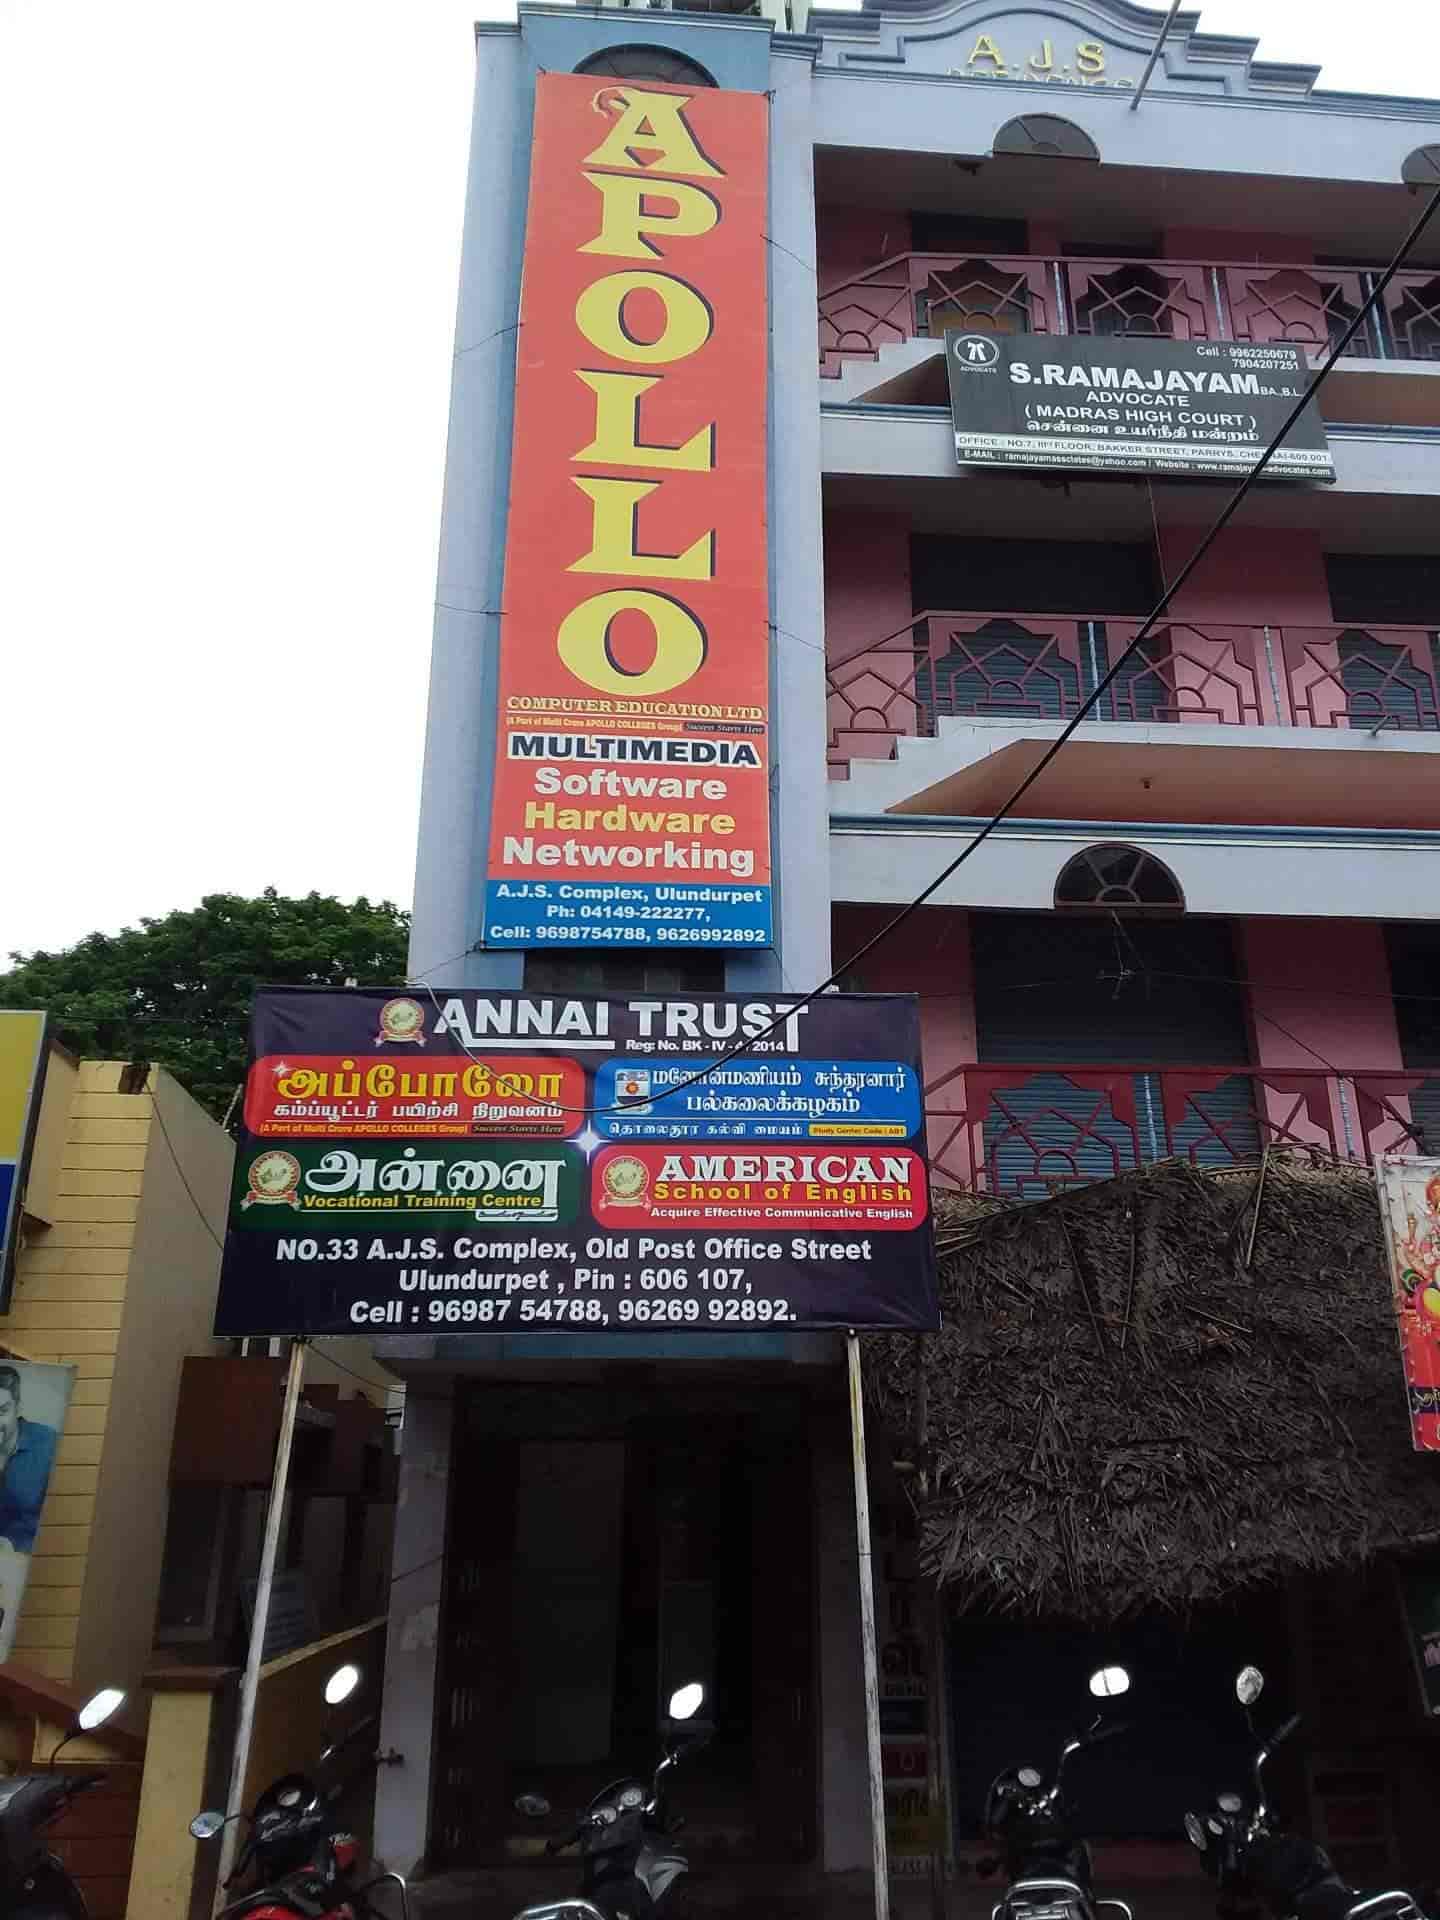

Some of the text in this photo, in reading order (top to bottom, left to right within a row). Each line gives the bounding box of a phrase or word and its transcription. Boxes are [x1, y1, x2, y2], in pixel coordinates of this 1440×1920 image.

[967, 35, 1105, 74] A.J.S
[556, 84, 729, 697] APOLLO
[1009, 362, 1260, 395] S.RAMAJAYAM
[1087, 390, 1191, 407] ADVOCATE
[1036, 405, 1120, 420] MADRAS
[1126, 408, 1172, 423] HIGH
[1178, 412, 1245, 427] COURT
[506, 696, 763, 720] COMPUTER EDUCATION LTD
[509, 733, 761, 767] MULTIMEDIA
[534, 767, 727, 800] Software
[525, 801, 736, 834] Hardware
[503, 837, 754, 877] Networking
[496, 884, 763, 904] A.J.S. Complex, Ulundurpet
[547, 905, 711, 922] Ph: 04149-222277,
[490, 926, 766, 943] Cell: 9698754788, 9626992892
[433, 998, 808, 1051] ANNAI TRUST
[682, 1040, 703, 1051] BK
[277, 1060, 564, 1099] அப்போலோ
[687, 1090, 860, 1118] பல்கலைக்கழகம்
[305, 1148, 566, 1206] அன்னை
[656, 1155, 909, 1183] AMERICAN
[304, 1193, 542, 1210] Vocational Training Centre
[654, 1183, 912, 1203] School of English
[651, 1207, 912, 1220] Acquire Effective Communicative English
[276, 1237, 872, 1264] NO.33 A.J.S. Complex, Old Post Office Street
[399, 1268, 549, 1295] Ulundurpet
[574, 1268, 615, 1290] Pin
[640, 1268, 688, 1291] 606
[697, 1268, 753, 1294] 107,
[350, 1300, 401, 1323] Cell
[428, 1300, 511, 1323] 96987
[519, 1299, 609, 1326] 54788,
[618, 1298, 700, 1321] 96269
[708, 1298, 797, 1321] 92892.
